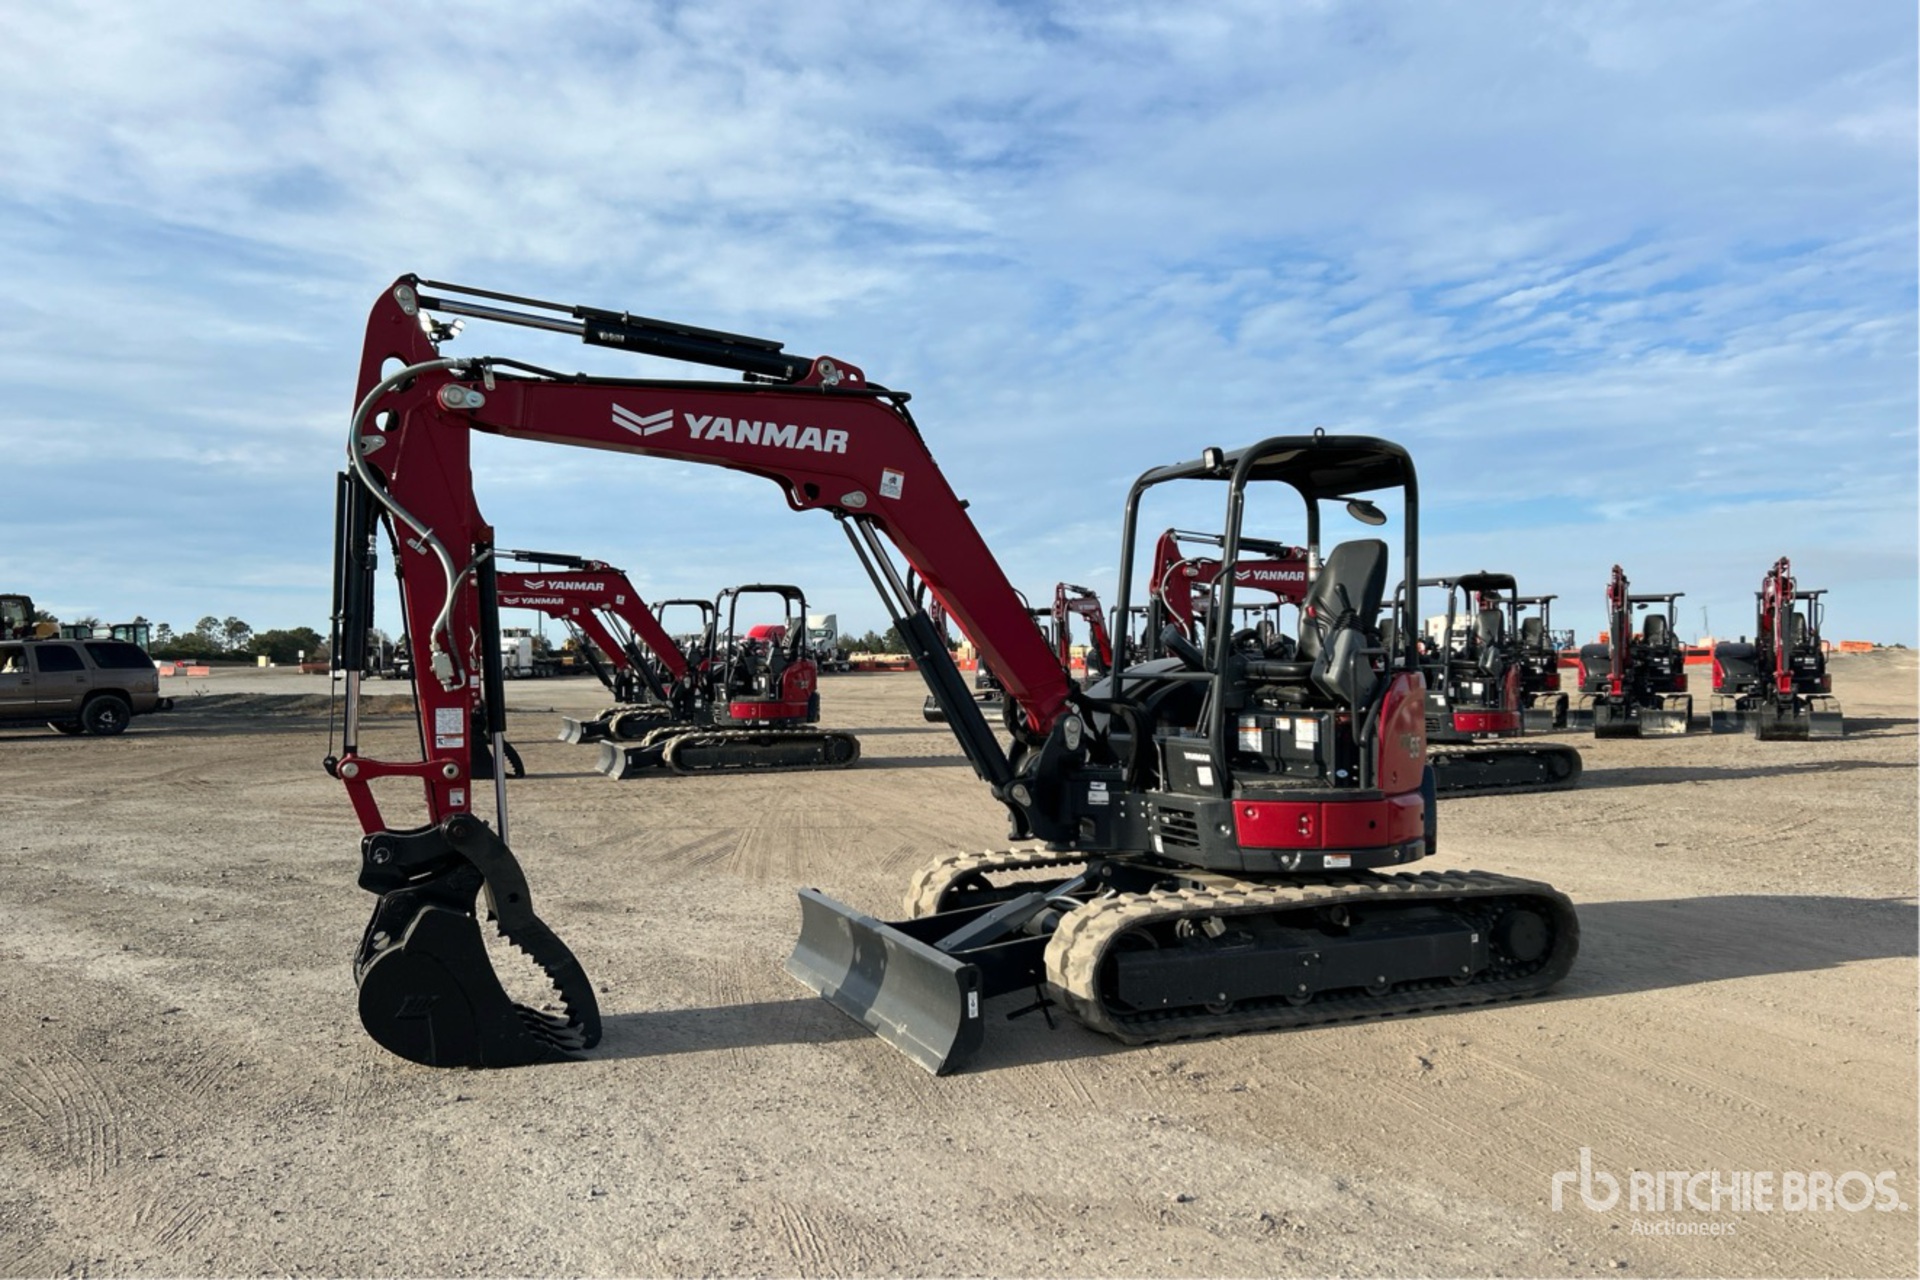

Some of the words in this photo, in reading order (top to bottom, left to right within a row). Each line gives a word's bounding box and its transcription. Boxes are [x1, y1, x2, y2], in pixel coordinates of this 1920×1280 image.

[684, 413, 849, 454] YANMAR
[1253, 570, 1305, 581] YANMAR
[547, 581, 605, 591] YANMAR
[521, 597, 564, 605] YANMAR
